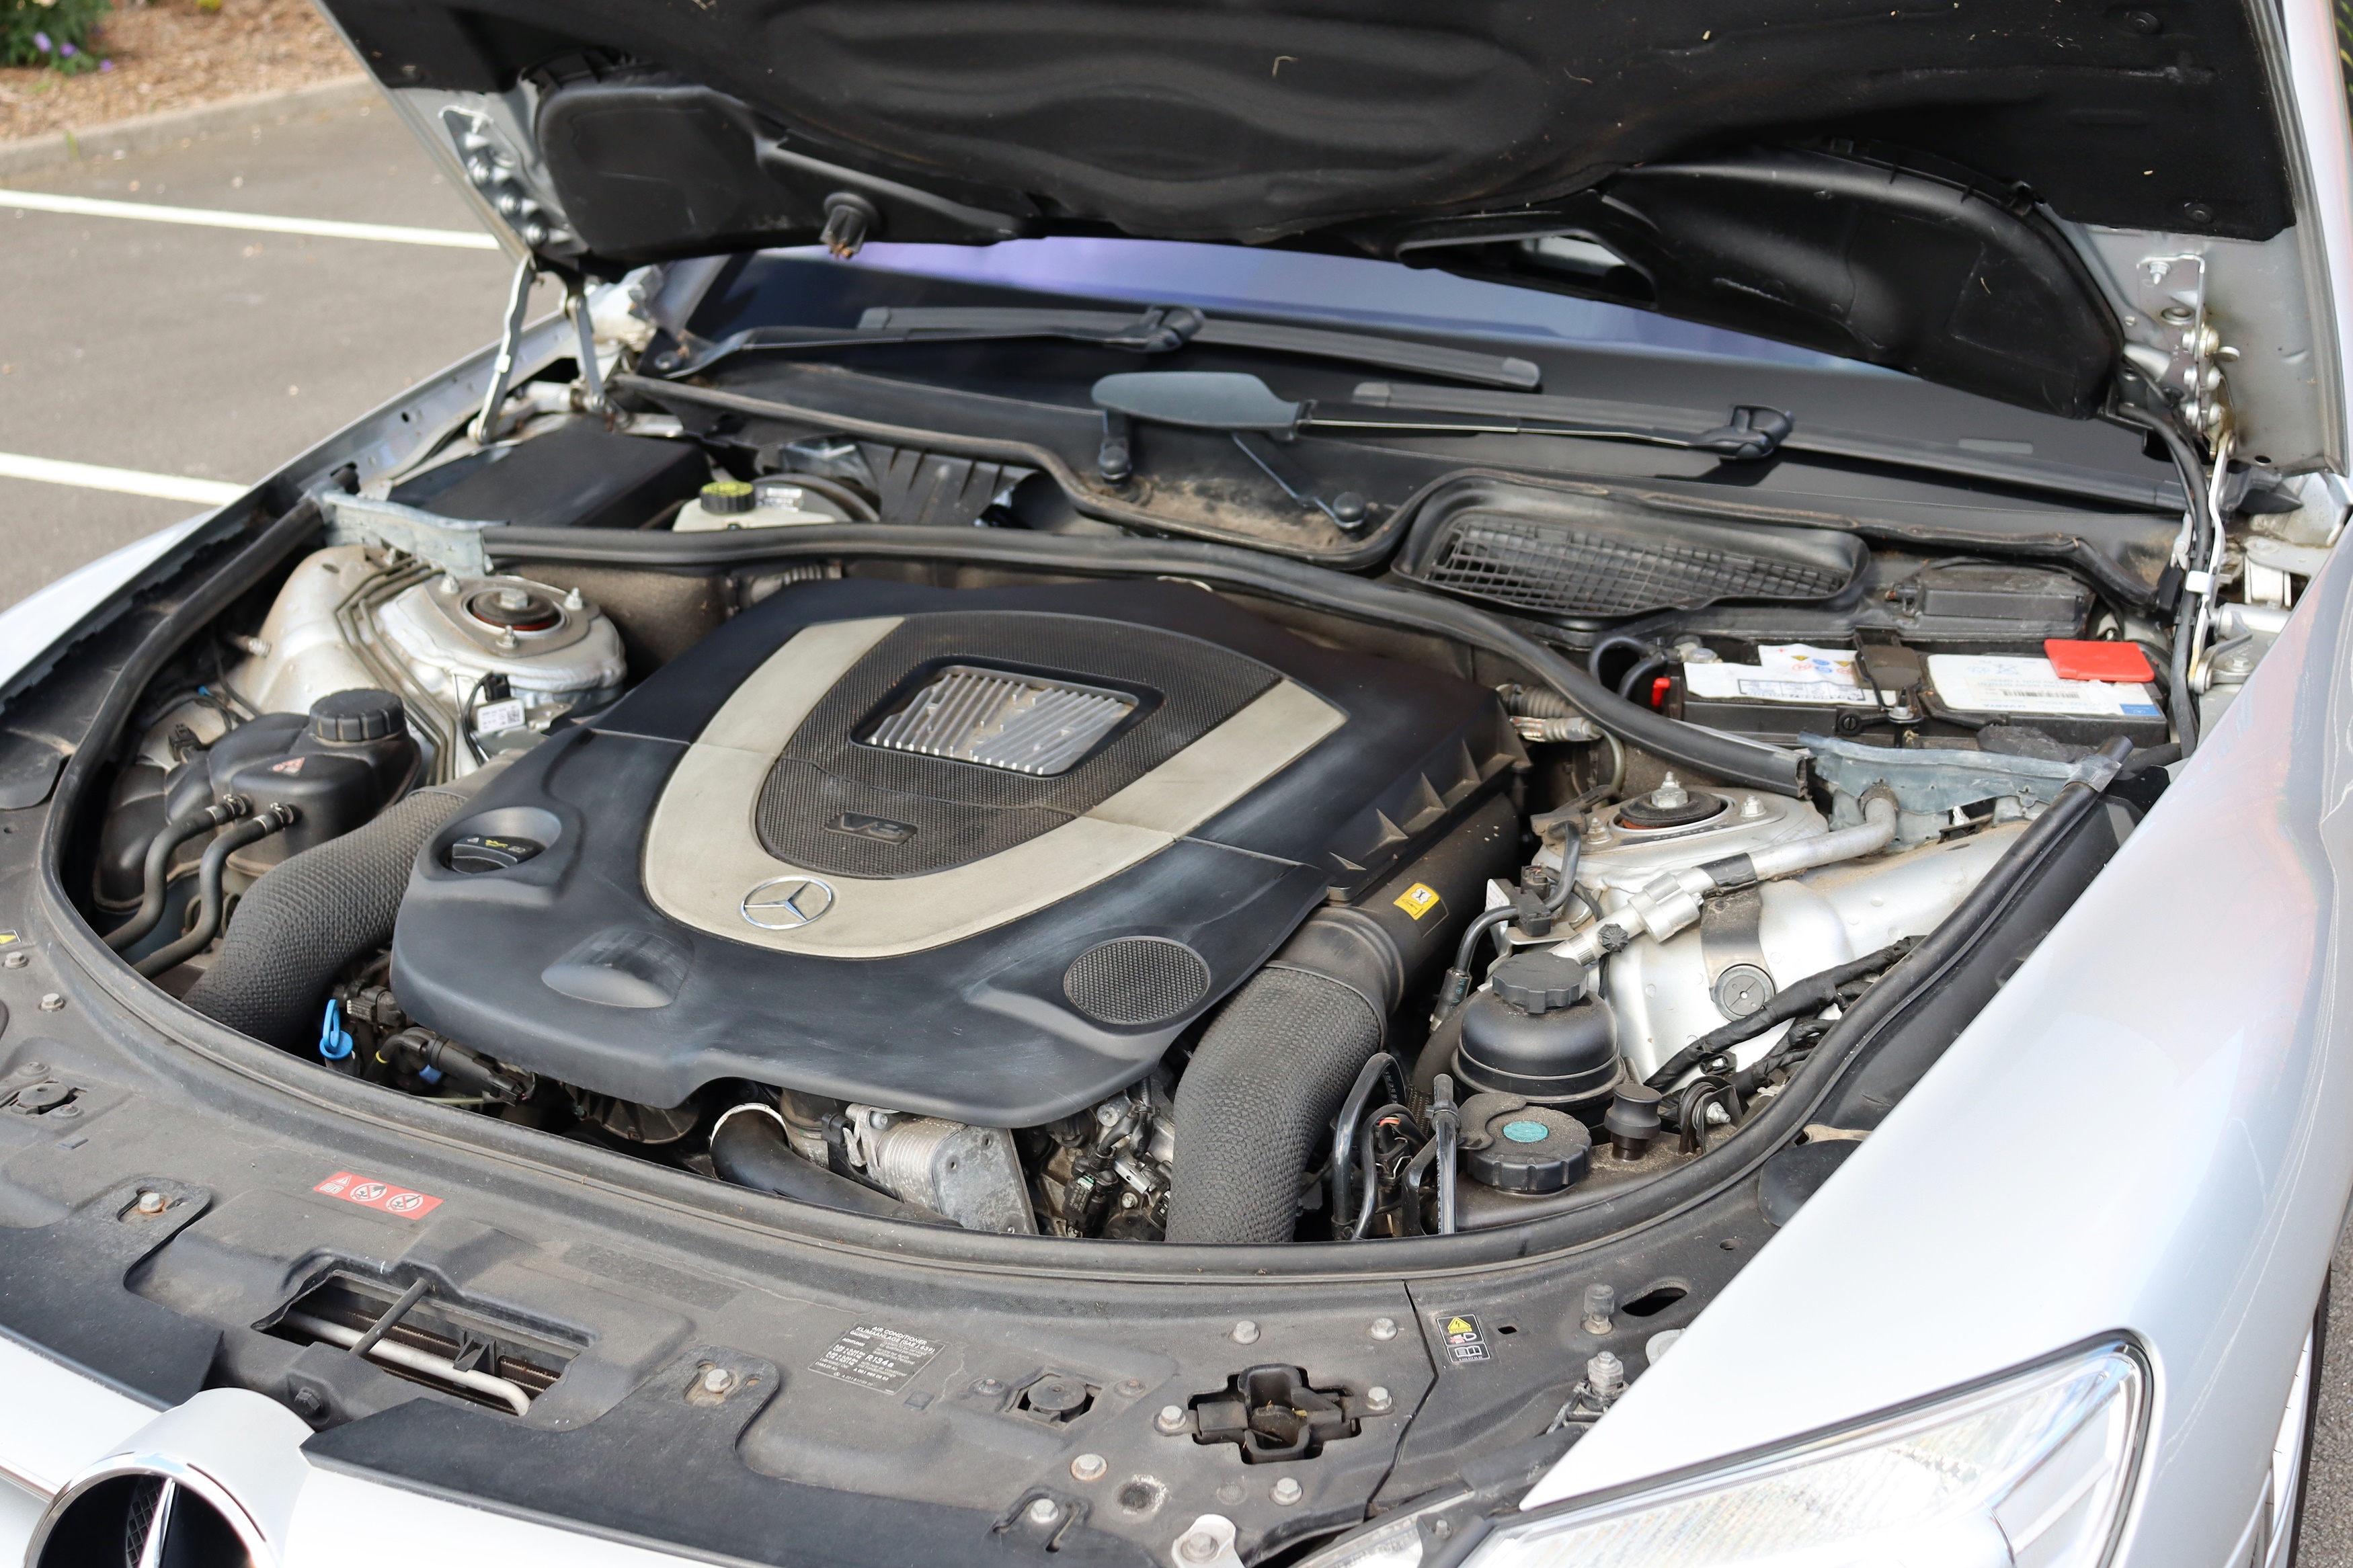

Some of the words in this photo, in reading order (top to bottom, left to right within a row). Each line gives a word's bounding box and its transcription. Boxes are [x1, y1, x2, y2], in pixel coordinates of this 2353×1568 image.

[850, 1331, 870, 1339] CAUTION!
[856, 1327, 900, 1342] KLIMAANLAGE
[920, 1346, 935, 1354] 639)
[884, 1330, 927, 1345] CONDITIONER
[842, 1338, 865, 1346] ACHTUNG!
[865, 1355, 894, 1368] R134a
